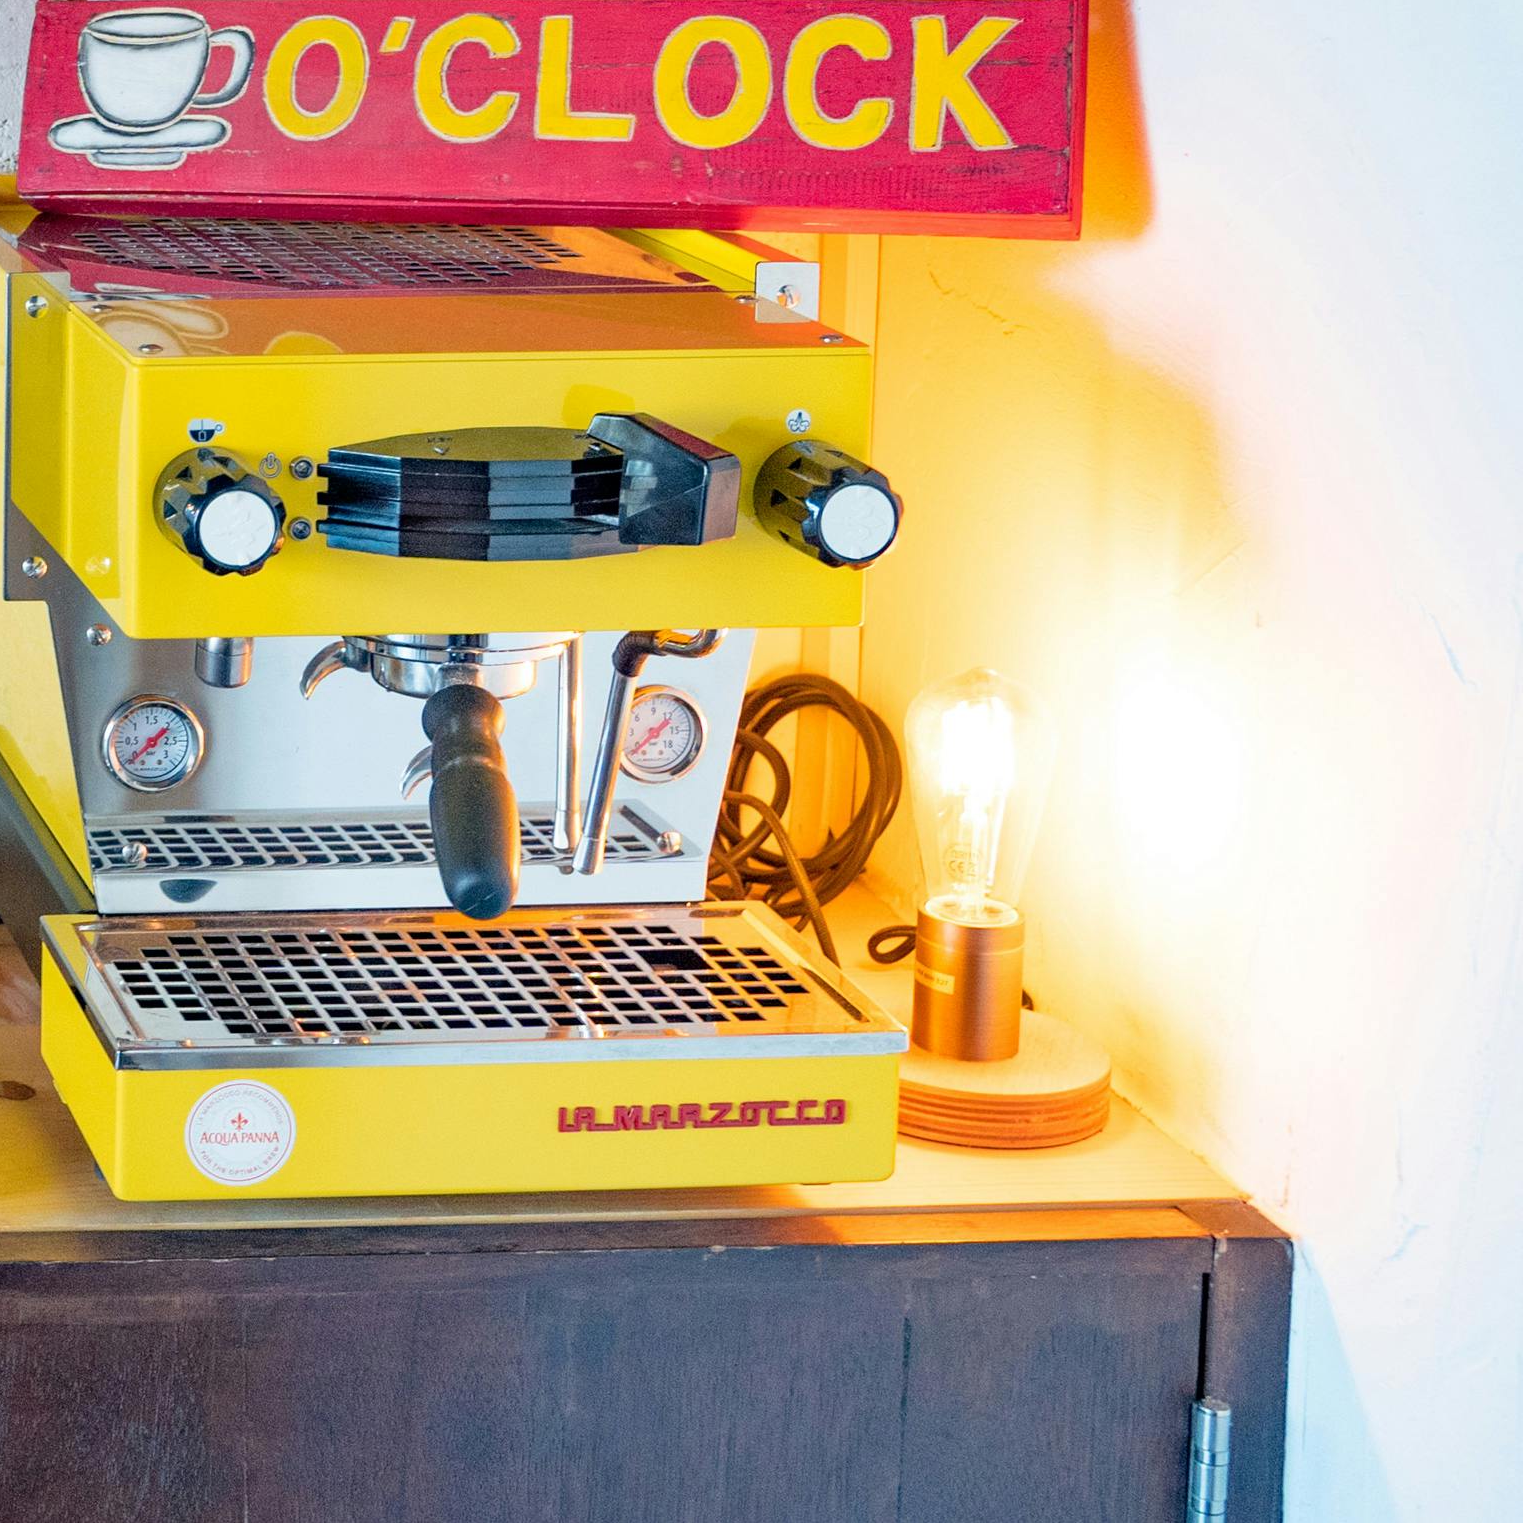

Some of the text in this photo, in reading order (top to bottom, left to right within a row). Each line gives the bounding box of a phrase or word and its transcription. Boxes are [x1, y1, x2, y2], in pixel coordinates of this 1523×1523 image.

[262, 14, 1024, 153] O'CLOCK
[145, 715, 158, 726] 1,5
[124, 736, 139, 747] 0,5
[163, 736, 177, 747] 2,5
[558, 1098, 847, 1133] LA MARZOCCO
[200, 1130, 280, 1146] ACQUA PANNA
